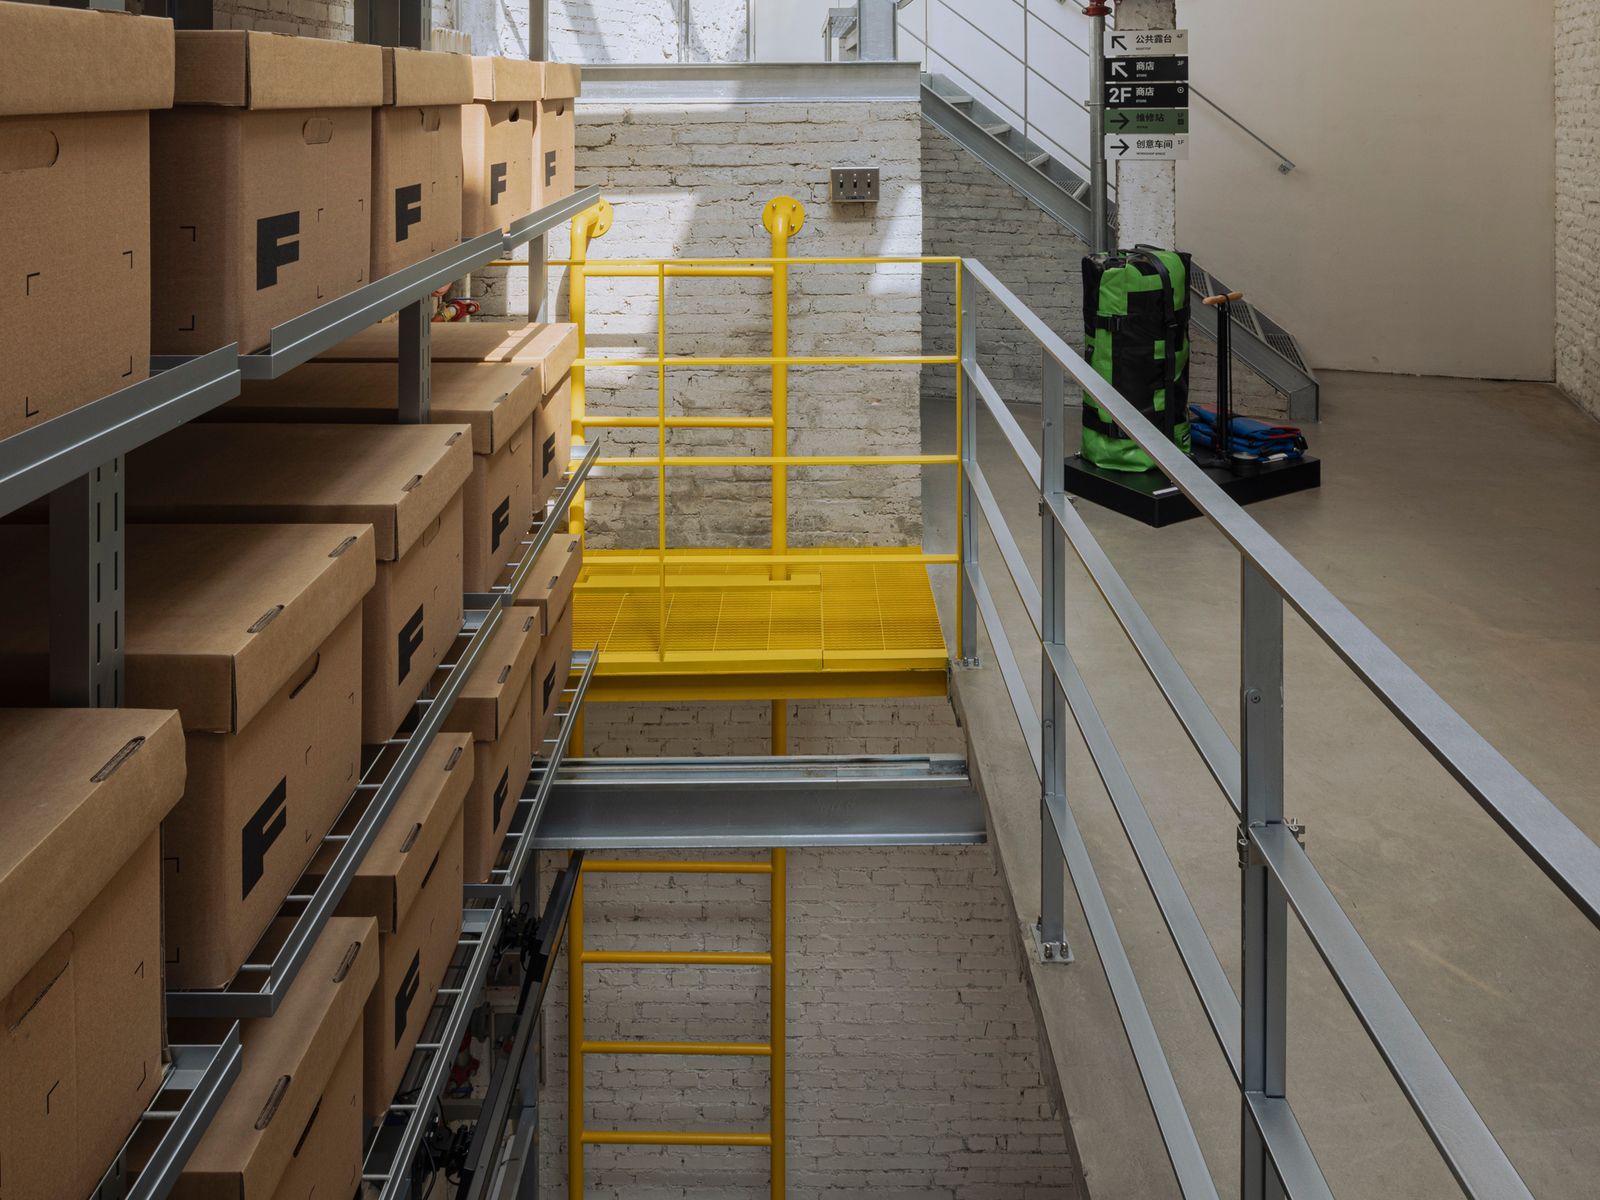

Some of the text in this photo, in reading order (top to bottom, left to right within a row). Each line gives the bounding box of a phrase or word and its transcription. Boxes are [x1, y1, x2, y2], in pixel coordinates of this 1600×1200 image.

[1135, 34, 1172, 44] 公共露台
[1136, 61, 1154, 71] 商店
[1109, 87, 1154, 103] 2F 商店
[1136, 140, 1173, 149] 创意车间
